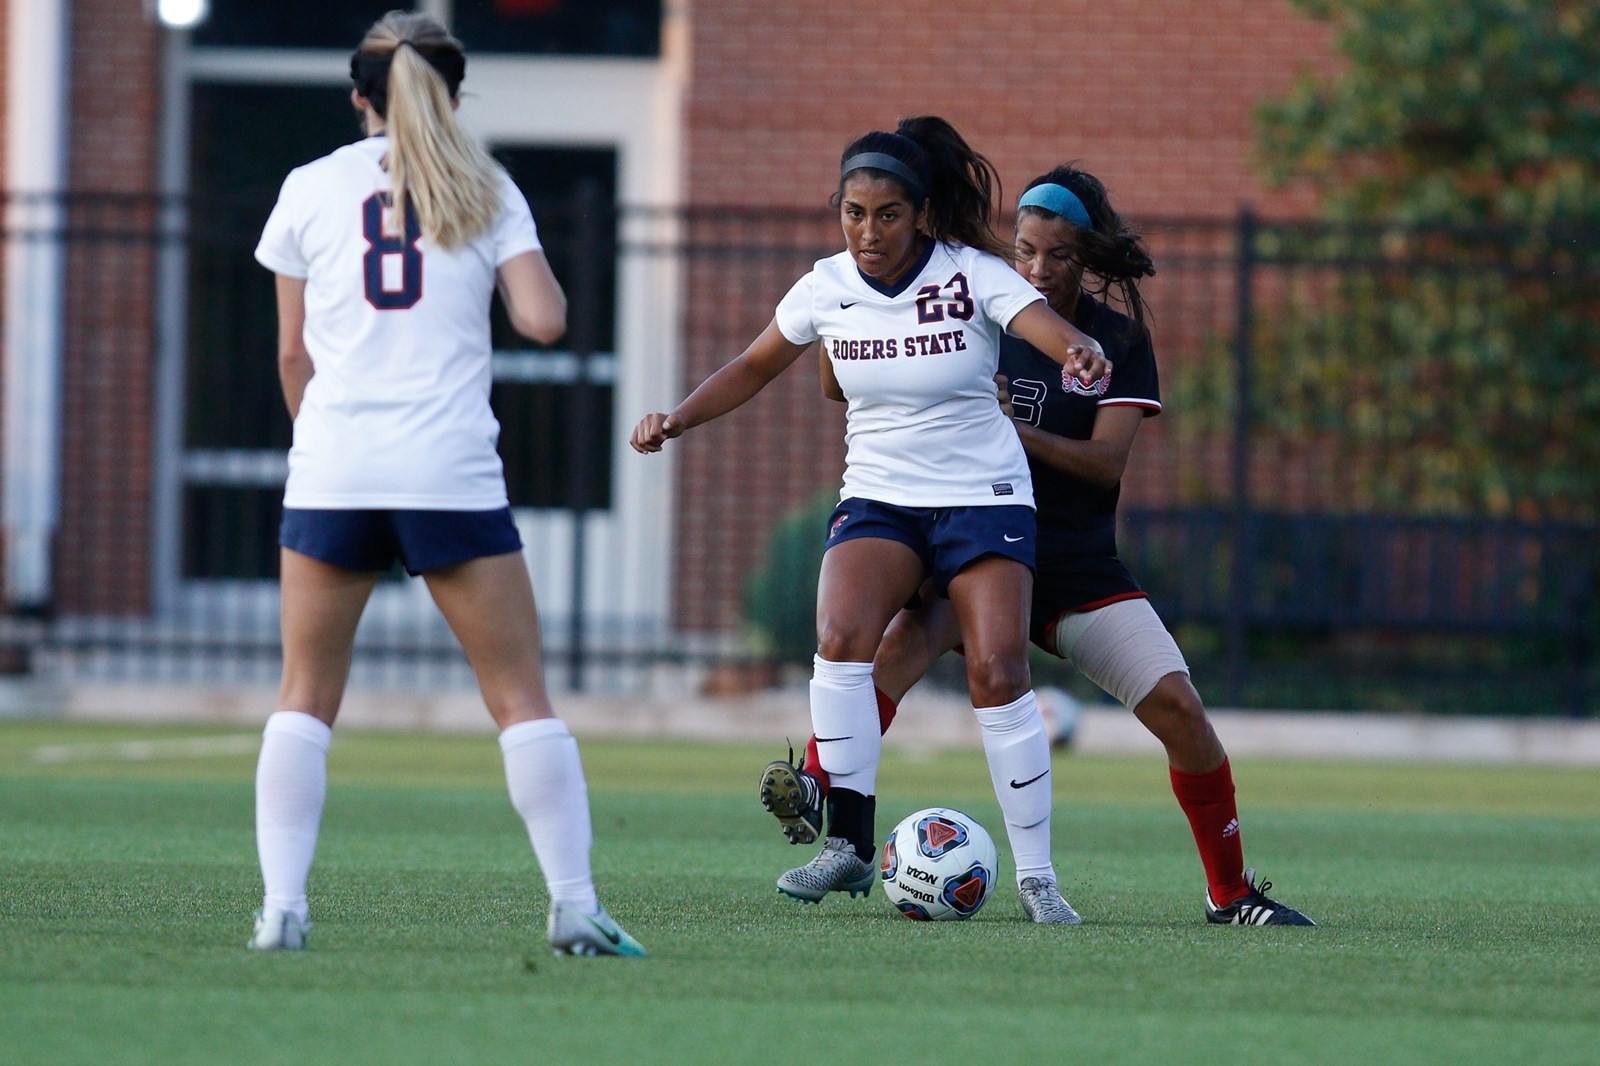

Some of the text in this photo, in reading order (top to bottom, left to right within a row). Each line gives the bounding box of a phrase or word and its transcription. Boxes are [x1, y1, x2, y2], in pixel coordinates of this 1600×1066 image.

[363, 190, 423, 310] 8
[915, 271, 974, 324] 23
[832, 329, 967, 361] ROGERS STATE
[906, 865, 938, 885] NCAA
[898, 880, 935, 904] Wilson
